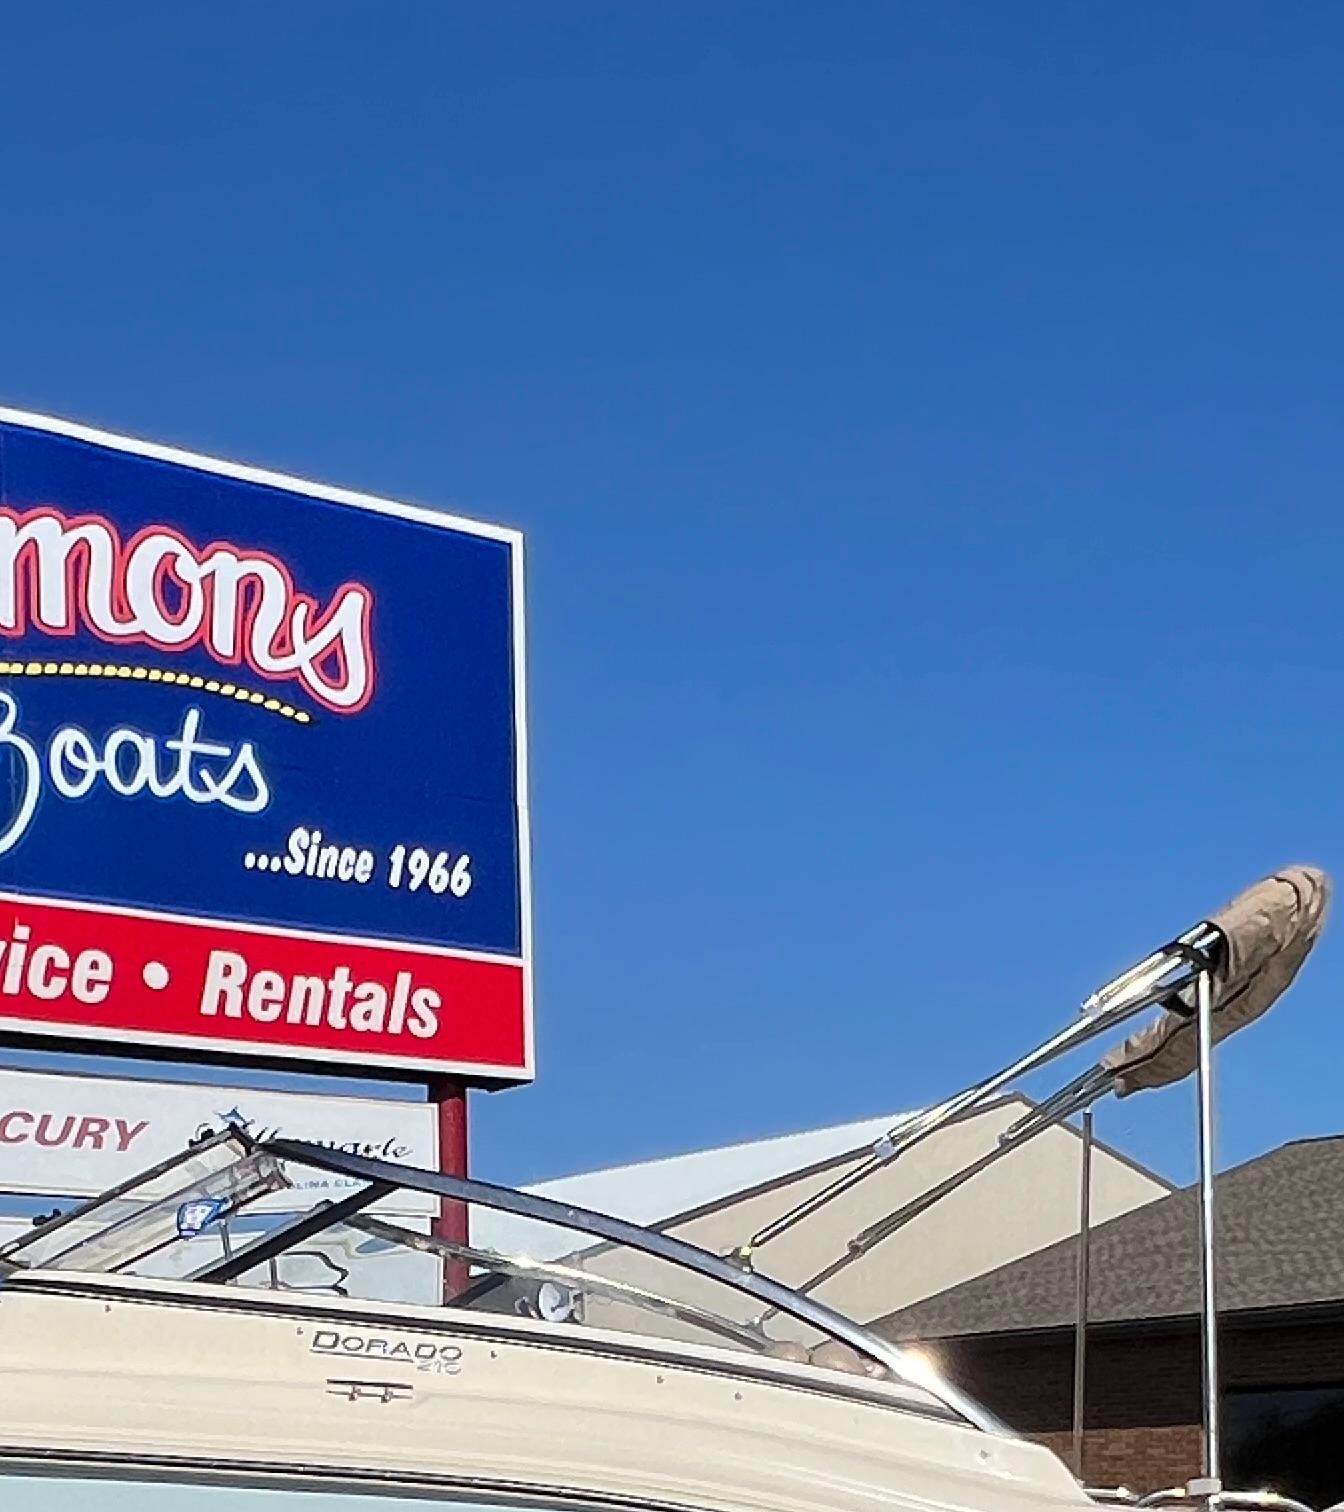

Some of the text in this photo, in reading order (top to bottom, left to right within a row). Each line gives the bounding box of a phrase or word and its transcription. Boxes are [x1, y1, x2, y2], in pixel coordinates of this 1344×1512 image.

[388, 844, 473, 898] 1966
[200, 948, 443, 1040] Rentals
[312, 1330, 463, 1361] DORADO
